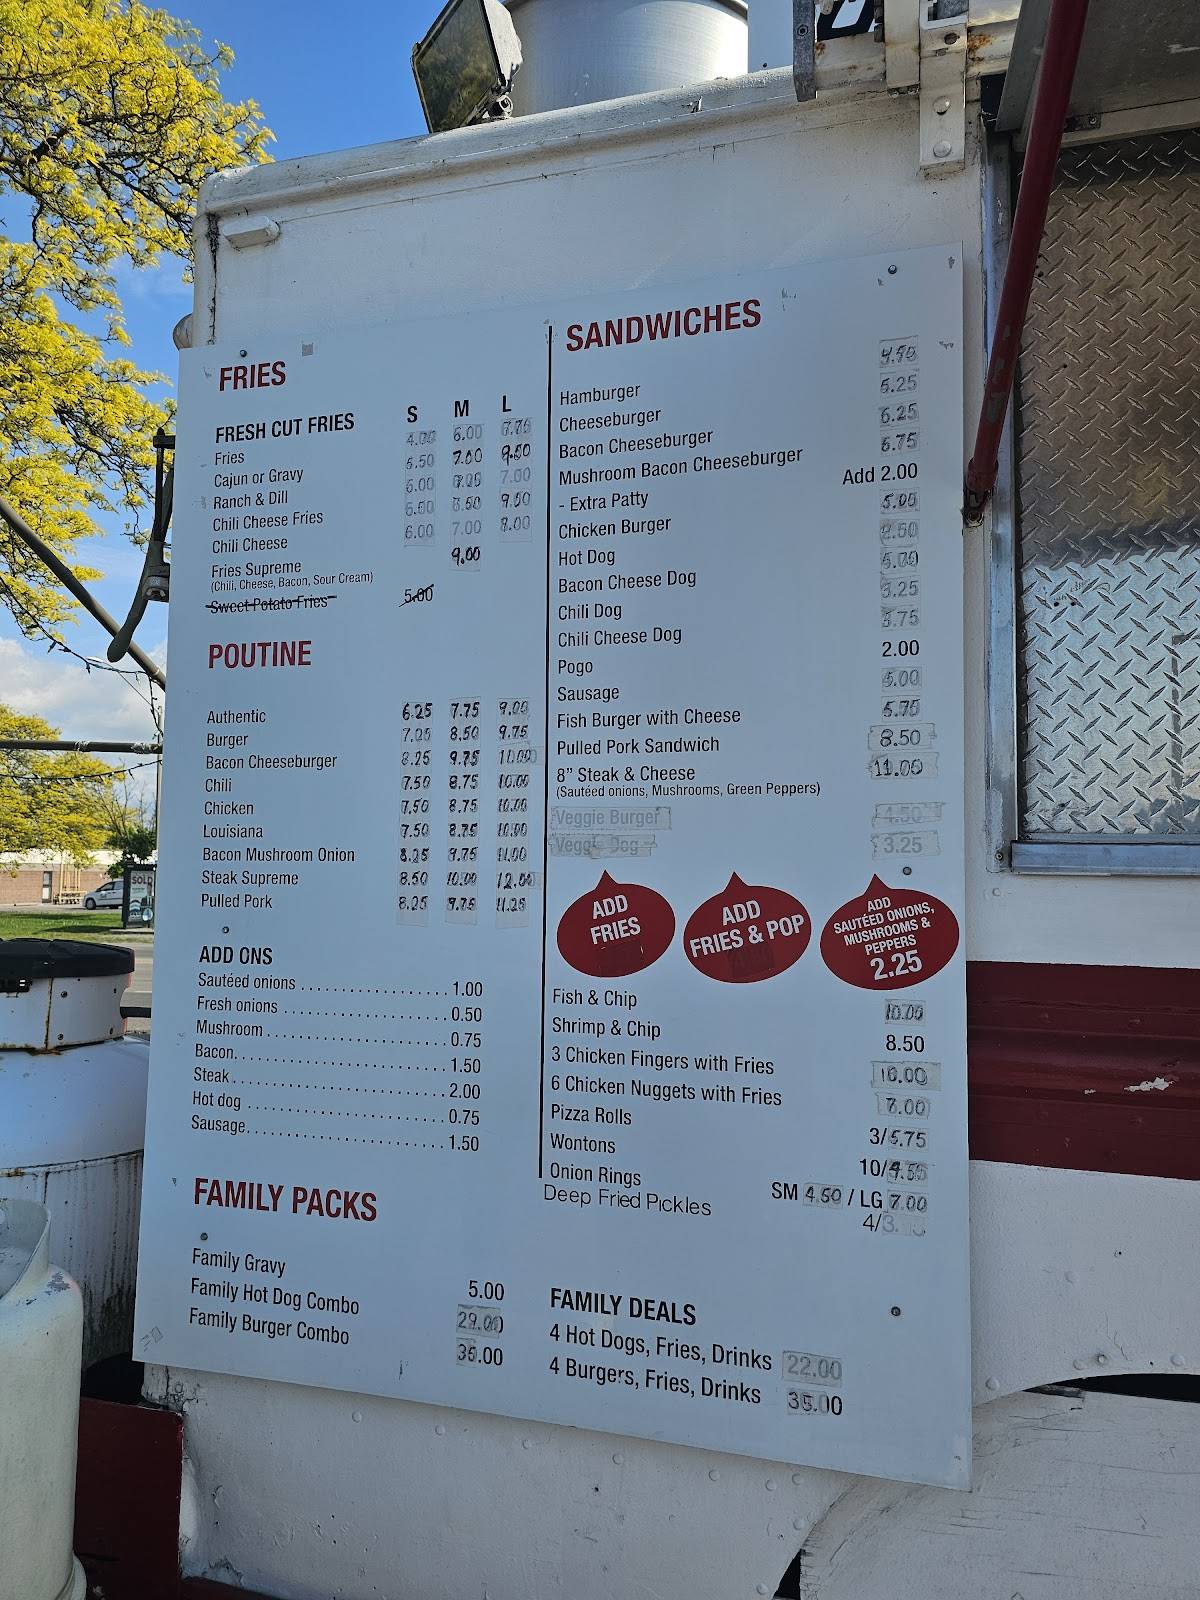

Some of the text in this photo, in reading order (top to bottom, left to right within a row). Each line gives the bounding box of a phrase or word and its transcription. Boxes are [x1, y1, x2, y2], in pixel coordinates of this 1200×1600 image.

[566, 299, 761, 351] SANDWICHES
[219, 361, 286, 391] FRIES
[560, 385, 641, 405] Hamburger
[407, 395, 512, 423] S M L
[216, 413, 354, 443] FRESH CUT FRIES
[560, 410, 661, 432] Cheeseburger
[560, 431, 713, 459] Bacon Cheeseburger
[215, 451, 244, 466] Fries
[560, 449, 803, 485] Mushroom Bacon Cheeseburger
[214, 469, 303, 490] Cajun or Gravy
[842, 463, 919, 486] Add 2.00
[214, 490, 288, 510] Ranch & Dill
[213, 510, 323, 532] Chili Cheese Fries
[559, 549, 615, 566] Hot Dog
[212, 562, 301, 578] Fries Supreme
[239, 579, 276, 590] Cheese,
[313, 574, 336, 585] Sour
[338, 572, 373, 584] Cream)
[559, 571, 696, 593] Bacon Cheese Dog
[558, 603, 622, 620] Chili Dog
[558, 627, 681, 647] Chili Cheese Dog
[209, 640, 311, 669] POUTINE
[881, 639, 920, 658] 2.00
[558, 660, 593, 677] Pogo
[558, 686, 619, 703] Sausage
[207, 708, 266, 724] Authentic
[402, 702, 433, 721] 6.25
[450, 702, 480, 720] 7.75
[558, 708, 740, 730] Fish Burger with Cheese
[207, 733, 248, 749] Burger
[558, 736, 719, 755] Pulled Pork Sandwich
[206, 754, 337, 771] Bacon Cheeseburger
[205, 778, 231, 792] Chili
[608, 785, 648, 798] onions,
[652, 784, 723, 797] Mushrooms,
[727, 783, 762, 795] Green
[766, 781, 820, 797] Peppers)
[204, 801, 254, 815] Chicken
[203, 824, 263, 838] Louisiana
[203, 847, 354, 862] Bacon Mushroom Onion
[202, 870, 298, 888] Steak Supreme
[202, 893, 272, 908] Pulled Pork
[593, 895, 628, 919] ADD
[868, 897, 891, 912] ADD
[723, 900, 760, 926] ADD
[833, 901, 935, 935] SAUTÉED ONIONS,
[590, 917, 641, 945] FRIES
[690, 914, 804, 958] FRIES & POP
[844, 917, 931, 947] MUSHROOMS &
[865, 934, 916, 955] PEPPERS
[199, 946, 272, 965] ADD ONS
[869, 948, 923, 981] 2.25
[198, 972, 295, 990] Sautéed onions
[452, 981, 484, 997] 1.00
[197, 996, 278, 1014] Fresh onions
[553, 988, 637, 1010] Fish & Chip
[451, 1007, 483, 1023] 0.50
[197, 1020, 263, 1037] Mushroom
[553, 1017, 660, 1041] Shrimp & Chip
[450, 1032, 482, 1049] 0.75
[885, 1034, 926, 1054] 8.50
[195, 1043, 233, 1059] Bacon
[194, 1067, 229, 1083] Steak
[450, 1058, 482, 1074] 1.50
[449, 1083, 481, 1100] 2.00
[551, 1075, 782, 1106] 6 Chicken Nuggets with Fries
[193, 1091, 241, 1112] Hot dog
[448, 1109, 480, 1126] 0.75
[552, 1104, 631, 1125] Pizza Rolls
[191, 1114, 245, 1136] Sausage
[448, 1135, 480, 1152] 1.50
[550, 1133, 615, 1154] Wontons
[550, 1162, 641, 1189] Onion Rings
[194, 1178, 377, 1221] FAMILY PACKS
[544, 1184, 711, 1216] Deep Fried Pickles
[193, 1248, 286, 1278] Family Gravy
[191, 1277, 359, 1315] Family Hot Dog Combo
[468, 1280, 505, 1301] 5.00
[551, 1288, 696, 1325] FAMILY DEALS
[550, 1324, 772, 1370] 4 Hot Dogs, Fries, Drinks
[787, 1353, 843, 1381] 22.00
[549, 1356, 760, 1404] 4 Burgers, Fries, Drinks
